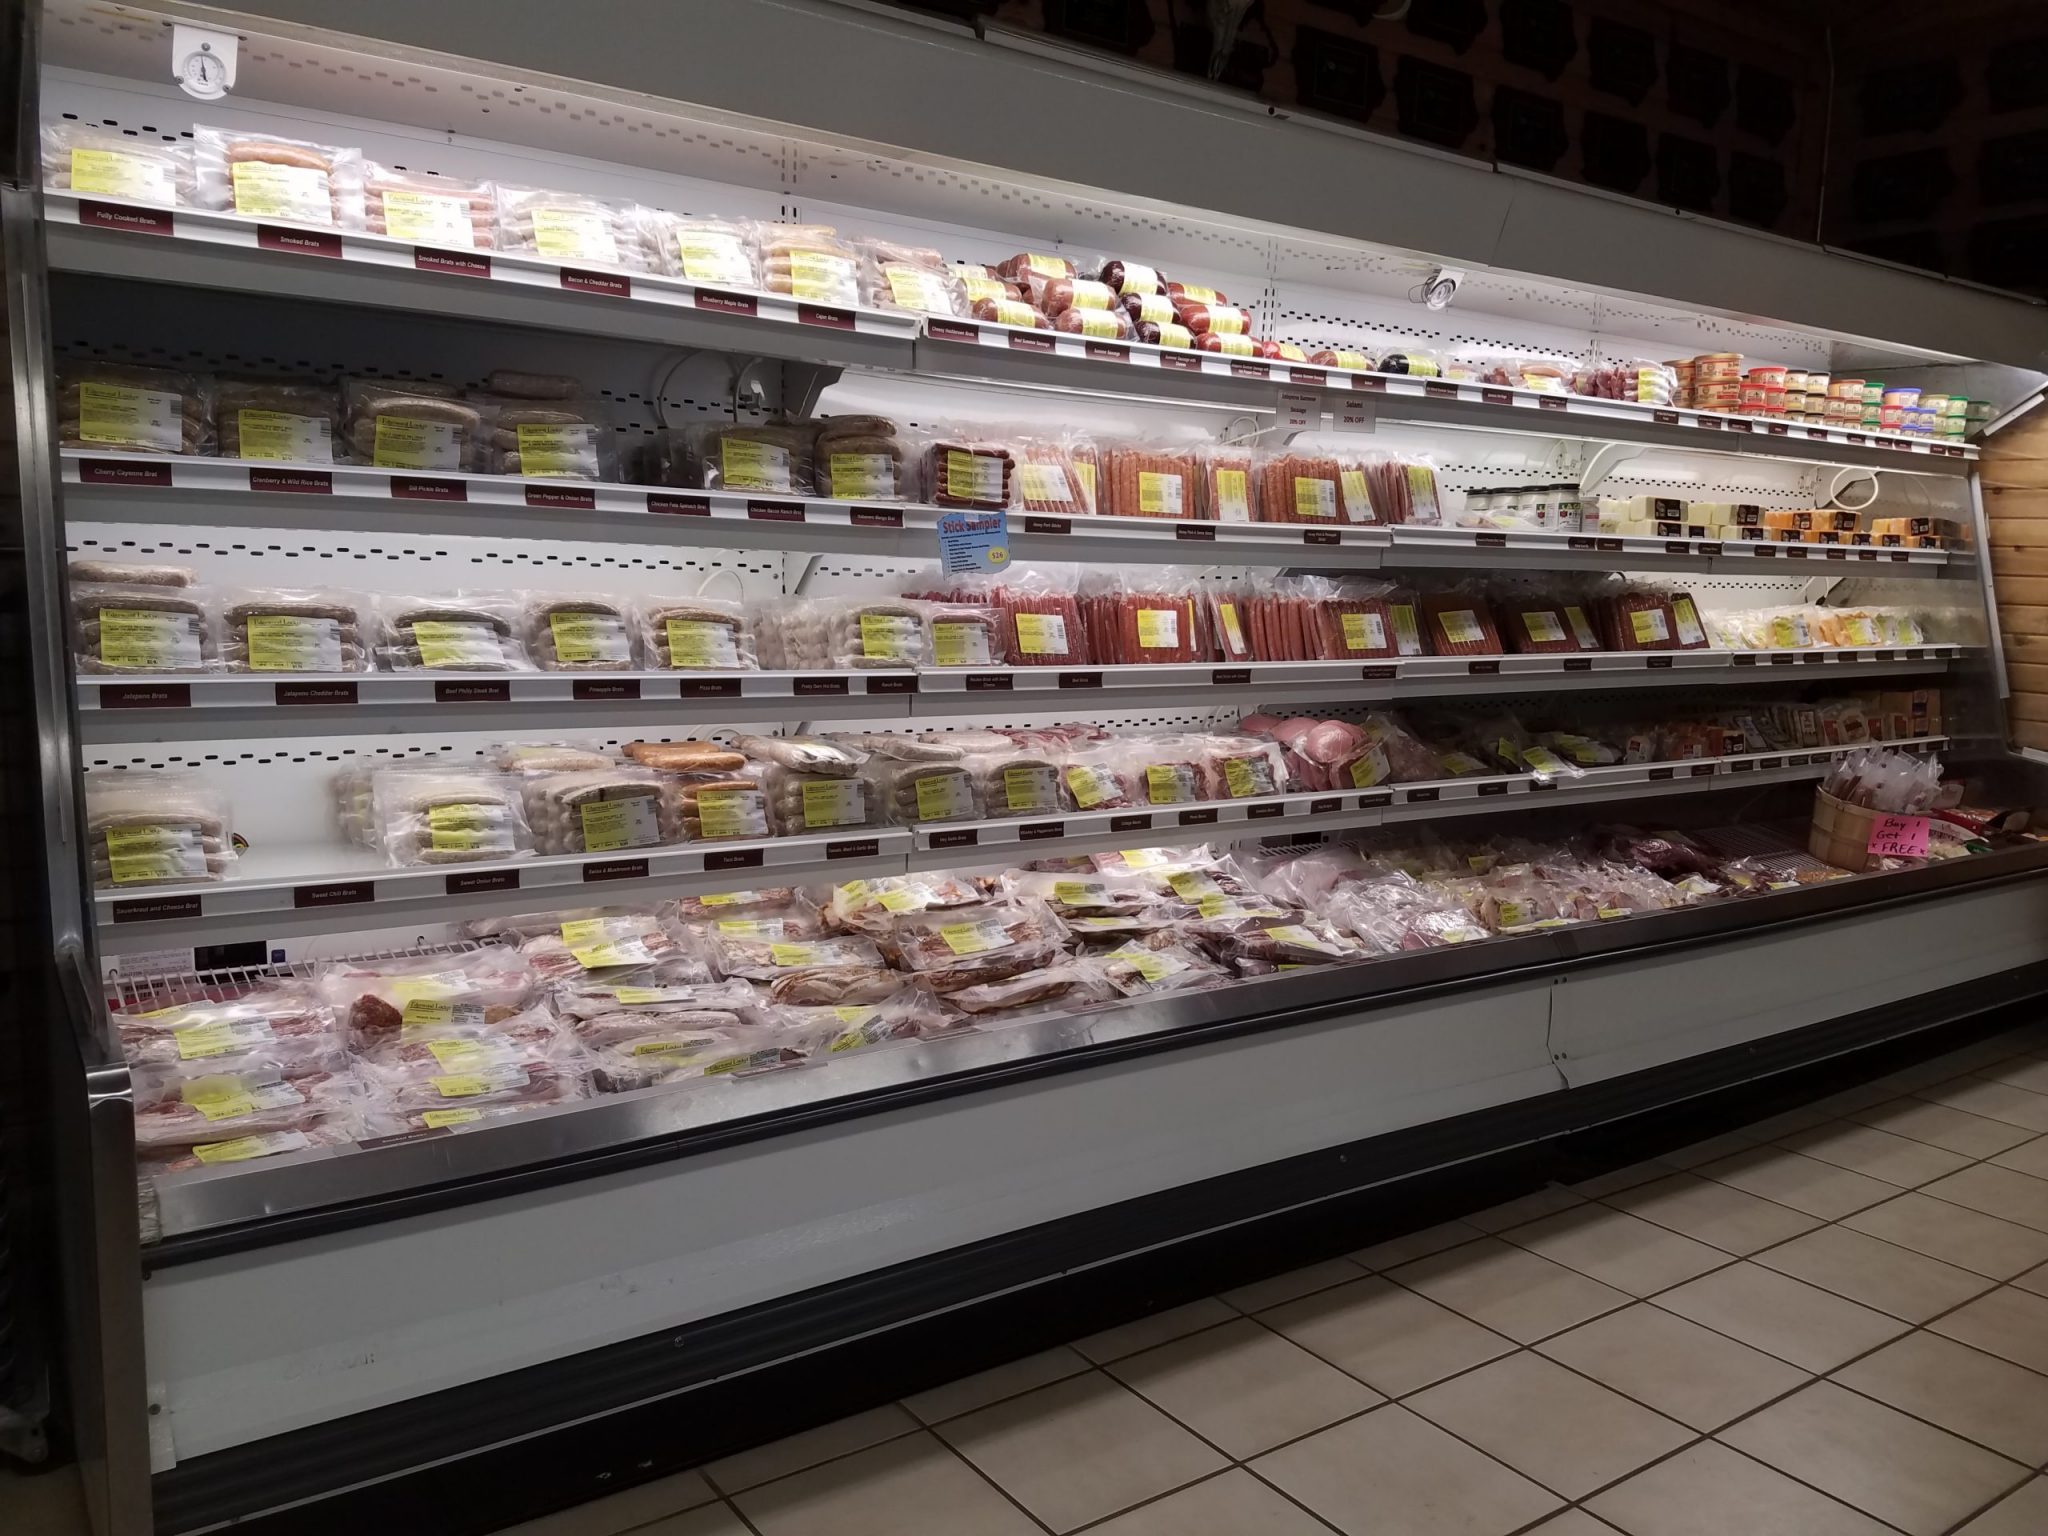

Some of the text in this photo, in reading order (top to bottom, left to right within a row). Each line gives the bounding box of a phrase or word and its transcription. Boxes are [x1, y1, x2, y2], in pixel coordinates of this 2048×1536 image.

[97, 211, 157, 225] Fully Cooked Brats
[280, 236, 319, 248] Smoked Brats
[418, 255, 440, 264] Smoked
[440, 258, 454, 266] Brats
[467, 261, 486, 270] Cheese
[568, 276, 583, 284] Bacon
[589, 278, 609, 287] Cheddar
[703, 296, 724, 305] Blueberry
[724, 299, 737, 307] Maple
[94, 468, 115, 477] Cherry
[117, 470, 144, 478] Cayenne
[252, 476, 281, 485] Cranberry
[542, 494, 559, 502] Pepper
[944, 517, 1001, 533] Stick Sampler
[122, 692, 150, 701] Jalapeno
[284, 690, 309, 698] Jalapeno
[1884, 818, 1906, 831] Buy
[1876, 830, 1903, 840] Get
[1882, 842, 1918, 854] FREE
[116, 907, 149, 915] Sauerkraut
